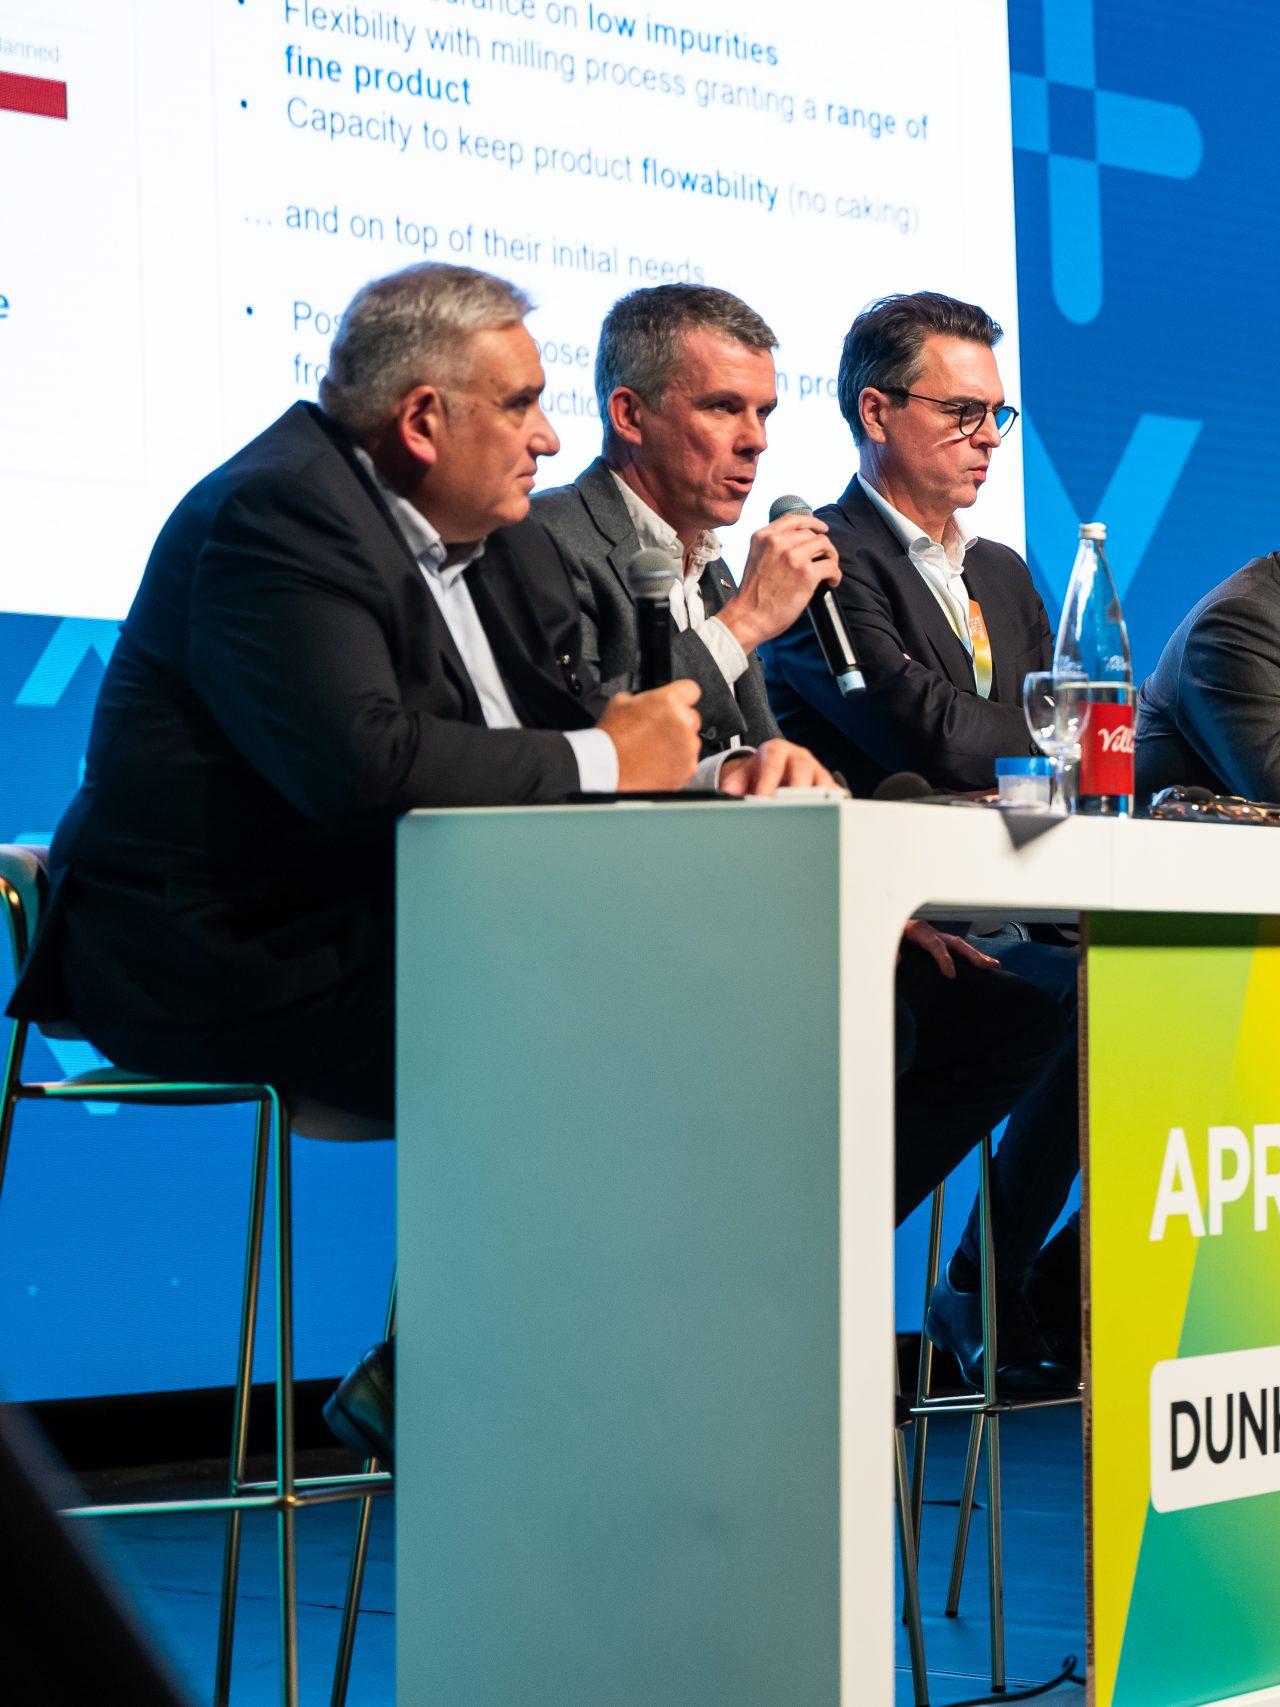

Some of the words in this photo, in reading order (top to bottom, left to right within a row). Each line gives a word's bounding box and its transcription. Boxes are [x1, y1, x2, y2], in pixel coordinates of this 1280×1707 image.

[285, 0, 416, 52] Flexibility
[426, 24, 480, 59] with
[491, 37, 575, 82] milling
[585, 55, 686, 96] process
[695, 77, 795, 122] granting
[804, 98, 817, 121] a
[827, 102, 897, 140] range
[906, 114, 929, 140] of
[546, 2, 578, 27] on
[588, 2, 636, 38] low
[646, 14, 779, 65] impurities
[285, 44, 342, 83] fine
[354, 64, 472, 105] product
[287, 96, 412, 153] Capacity
[423, 120, 448, 151] to
[458, 125, 523, 170] keep
[535, 145, 633, 183] product
[642, 157, 779, 212] flowability
[788, 183, 826, 215] (no
[835, 191, 921, 235] caking)
[285, 204, 339, 234] and
[350, 214, 384, 241] on
[395, 214, 438, 255] top
[449, 224, 474, 252] of
[484, 227, 543, 264] their
[552, 235, 619, 275] initial
[629, 255, 705, 285] needs
